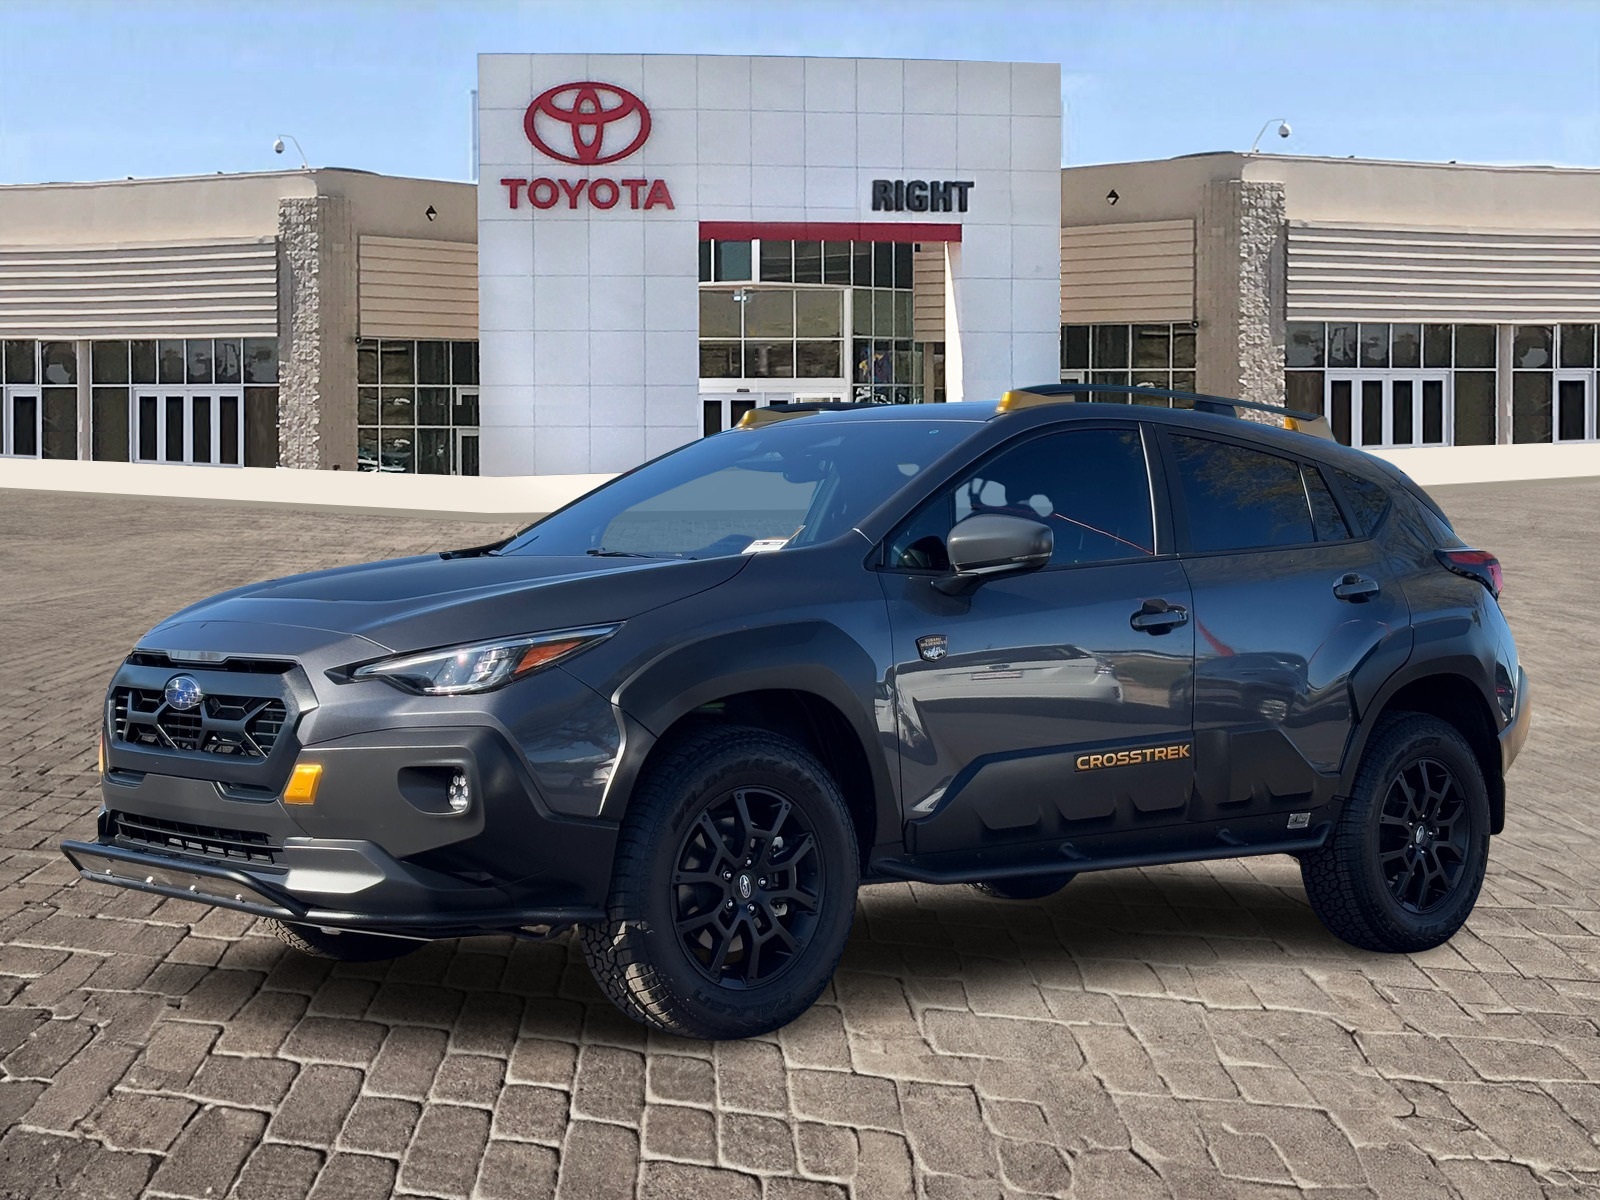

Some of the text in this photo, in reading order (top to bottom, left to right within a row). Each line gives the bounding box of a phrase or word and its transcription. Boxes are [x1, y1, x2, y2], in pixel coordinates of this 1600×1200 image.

[500, 177, 675, 210] TOYOTA
[872, 179, 975, 212] RIGHT
[1076, 744, 1190, 770] CROSSTREK
